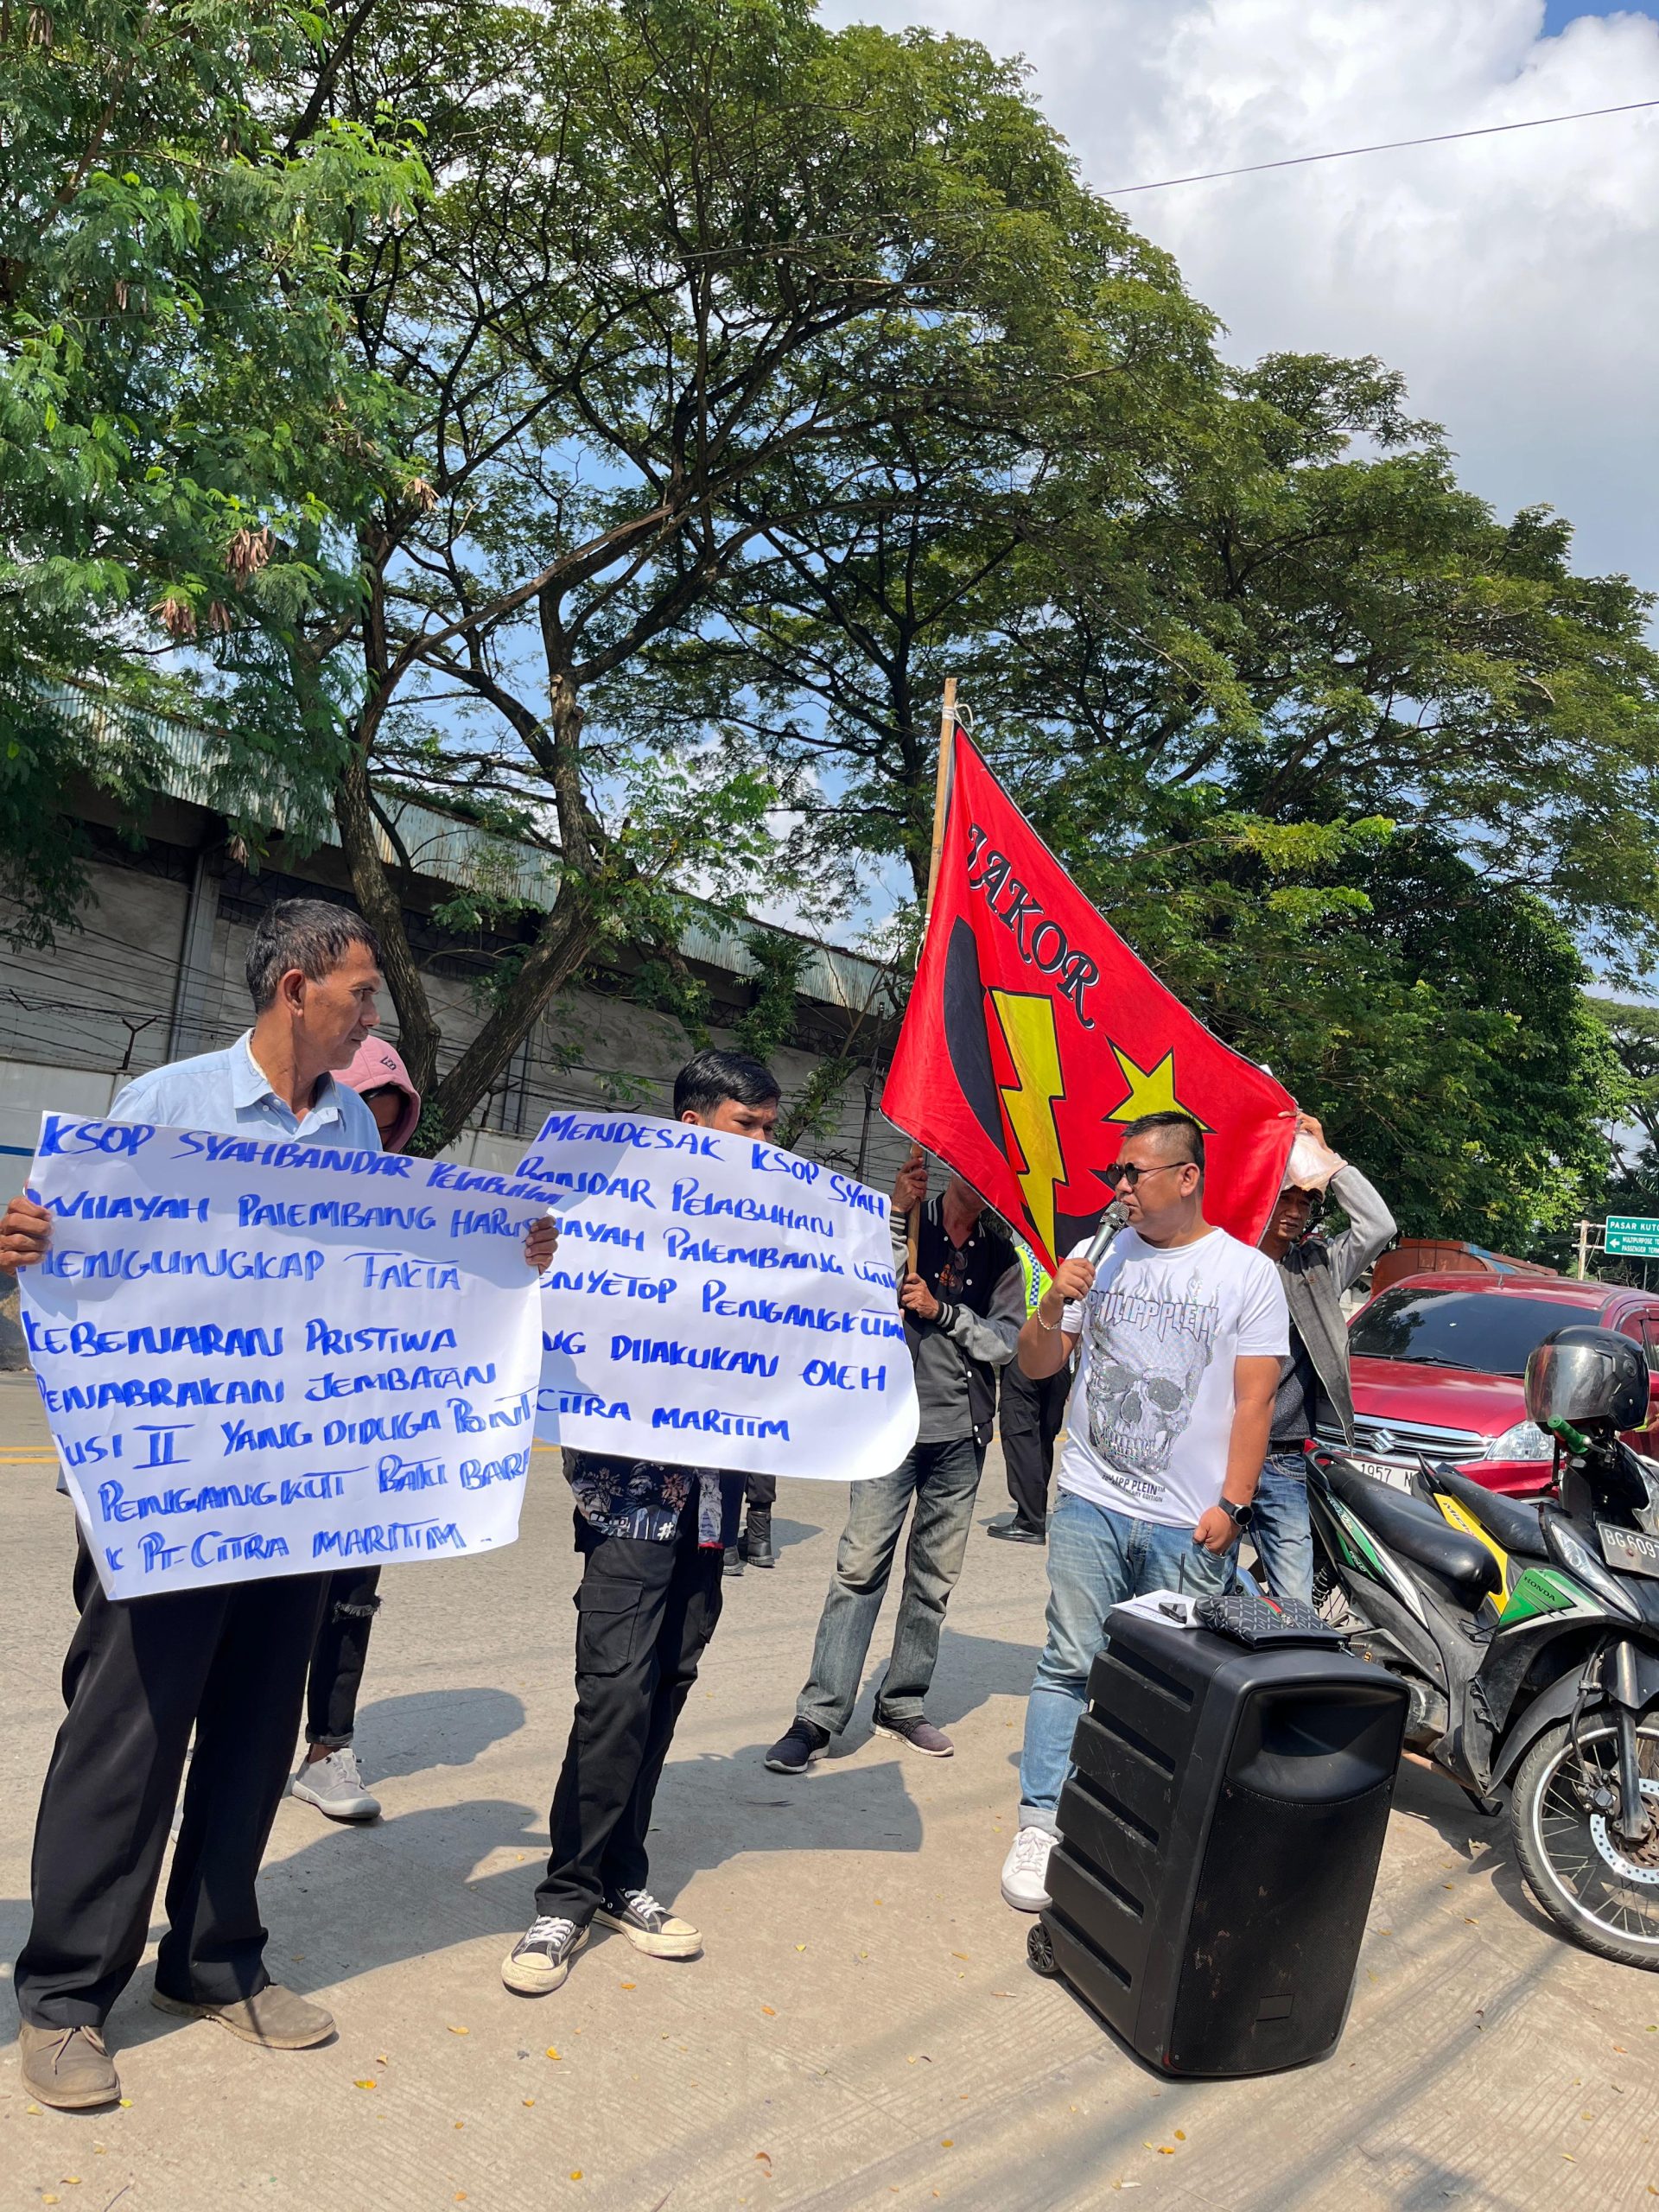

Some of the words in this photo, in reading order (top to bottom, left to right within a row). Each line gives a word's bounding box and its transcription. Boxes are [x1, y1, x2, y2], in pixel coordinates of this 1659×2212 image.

[38, 1116, 156, 1157] KSOP
[169, 1131, 415, 1179] SYAHBANDAR
[537, 1115, 726, 1162] MENDESAK
[751, 1143, 819, 1185] KSOP
[830, 1174, 886, 1220] SYAH
[26, 1188, 210, 1223] WILAYAH
[238, 1193, 436, 1230] PALEMBANG
[672, 1177, 834, 1238] PELABUHAN
[1610, 1221, 1637, 1230] PASAR
[344, 1252, 461, 1290] FAKTA
[663, 1226, 844, 1275] PALEMBANG
[540, 1268, 677, 1304] ENYETOP
[22, 1310, 284, 1357] KEBENARAN
[305, 1318, 458, 1357] PRISTIWA
[1088, 1289, 1160, 1332] PHILIPP
[1158, 1300, 1219, 1348] PLEIN
[542, 1330, 587, 1356] NG
[610, 1334, 779, 1378] DILAKUKAN
[802, 1358, 887, 1392] OLEH
[35, 1373, 285, 1414] PENABRAKAN
[304, 1363, 497, 1402] JEMBATAN
[57, 1433, 124, 1466] USI
[132, 1423, 195, 1470] II
[220, 1419, 314, 1457] YANG
[323, 1408, 442, 1446] DIDUGA
[446, 1384, 539, 1434] PONT
[652, 1407, 791, 1442] MARITIM
[1361, 1463, 1392, 1484] 1957
[312, 1517, 467, 1559] MARITIM
[1604, 1528, 1625, 1548] BG
[1626, 1532, 1659, 1559] 609
[1523, 1576, 1556, 1602] HONDA
